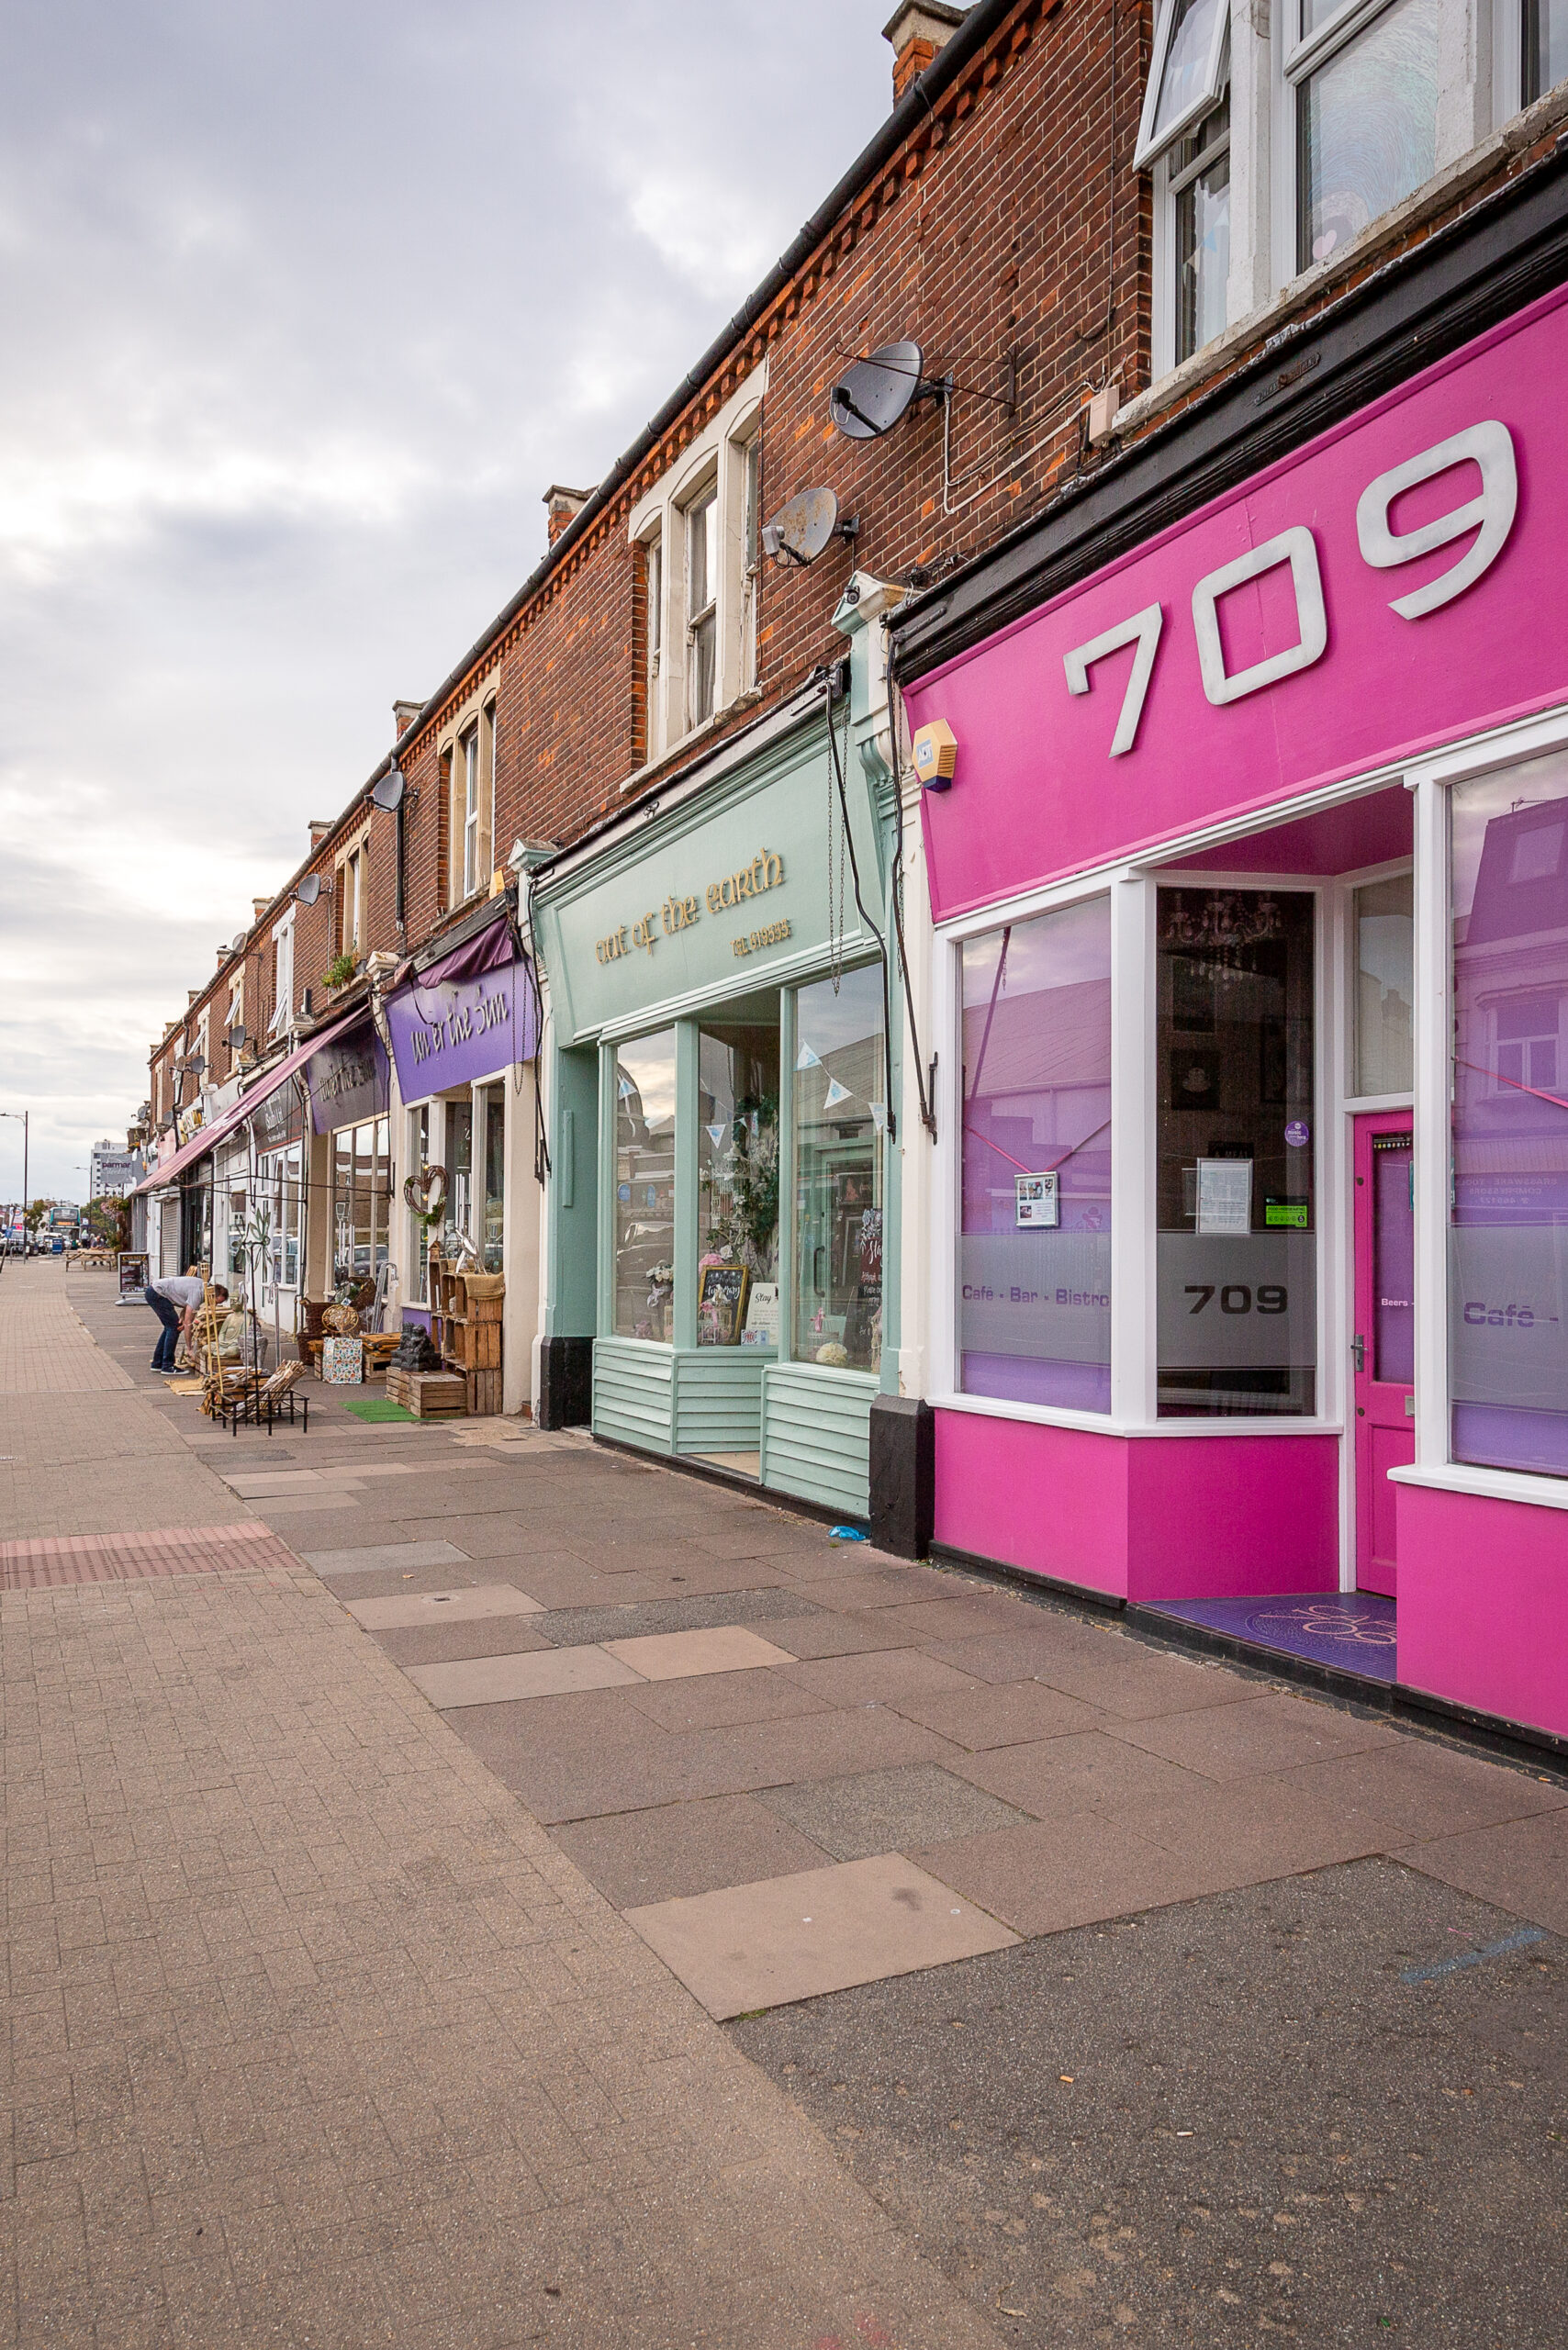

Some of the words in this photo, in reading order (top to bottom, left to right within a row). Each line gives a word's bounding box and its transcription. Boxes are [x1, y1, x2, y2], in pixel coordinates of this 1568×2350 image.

[1063, 420, 1518, 759] 709
[596, 924, 628, 965] out
[632, 912, 656, 956] of
[660, 895, 698, 935] the
[706, 847, 783, 914] earth
[755, 1292, 772, 1304] Stay
[962, 1284, 994, 1301] Café
[1010, 1286, 1038, 1303] Bar
[1056, 1288, 1110, 1307] Bistro
[1184, 1285, 1288, 1314] 709
[1381, 1298, 1408, 1306] Beers
[1464, 1302, 1535, 1327] Café
